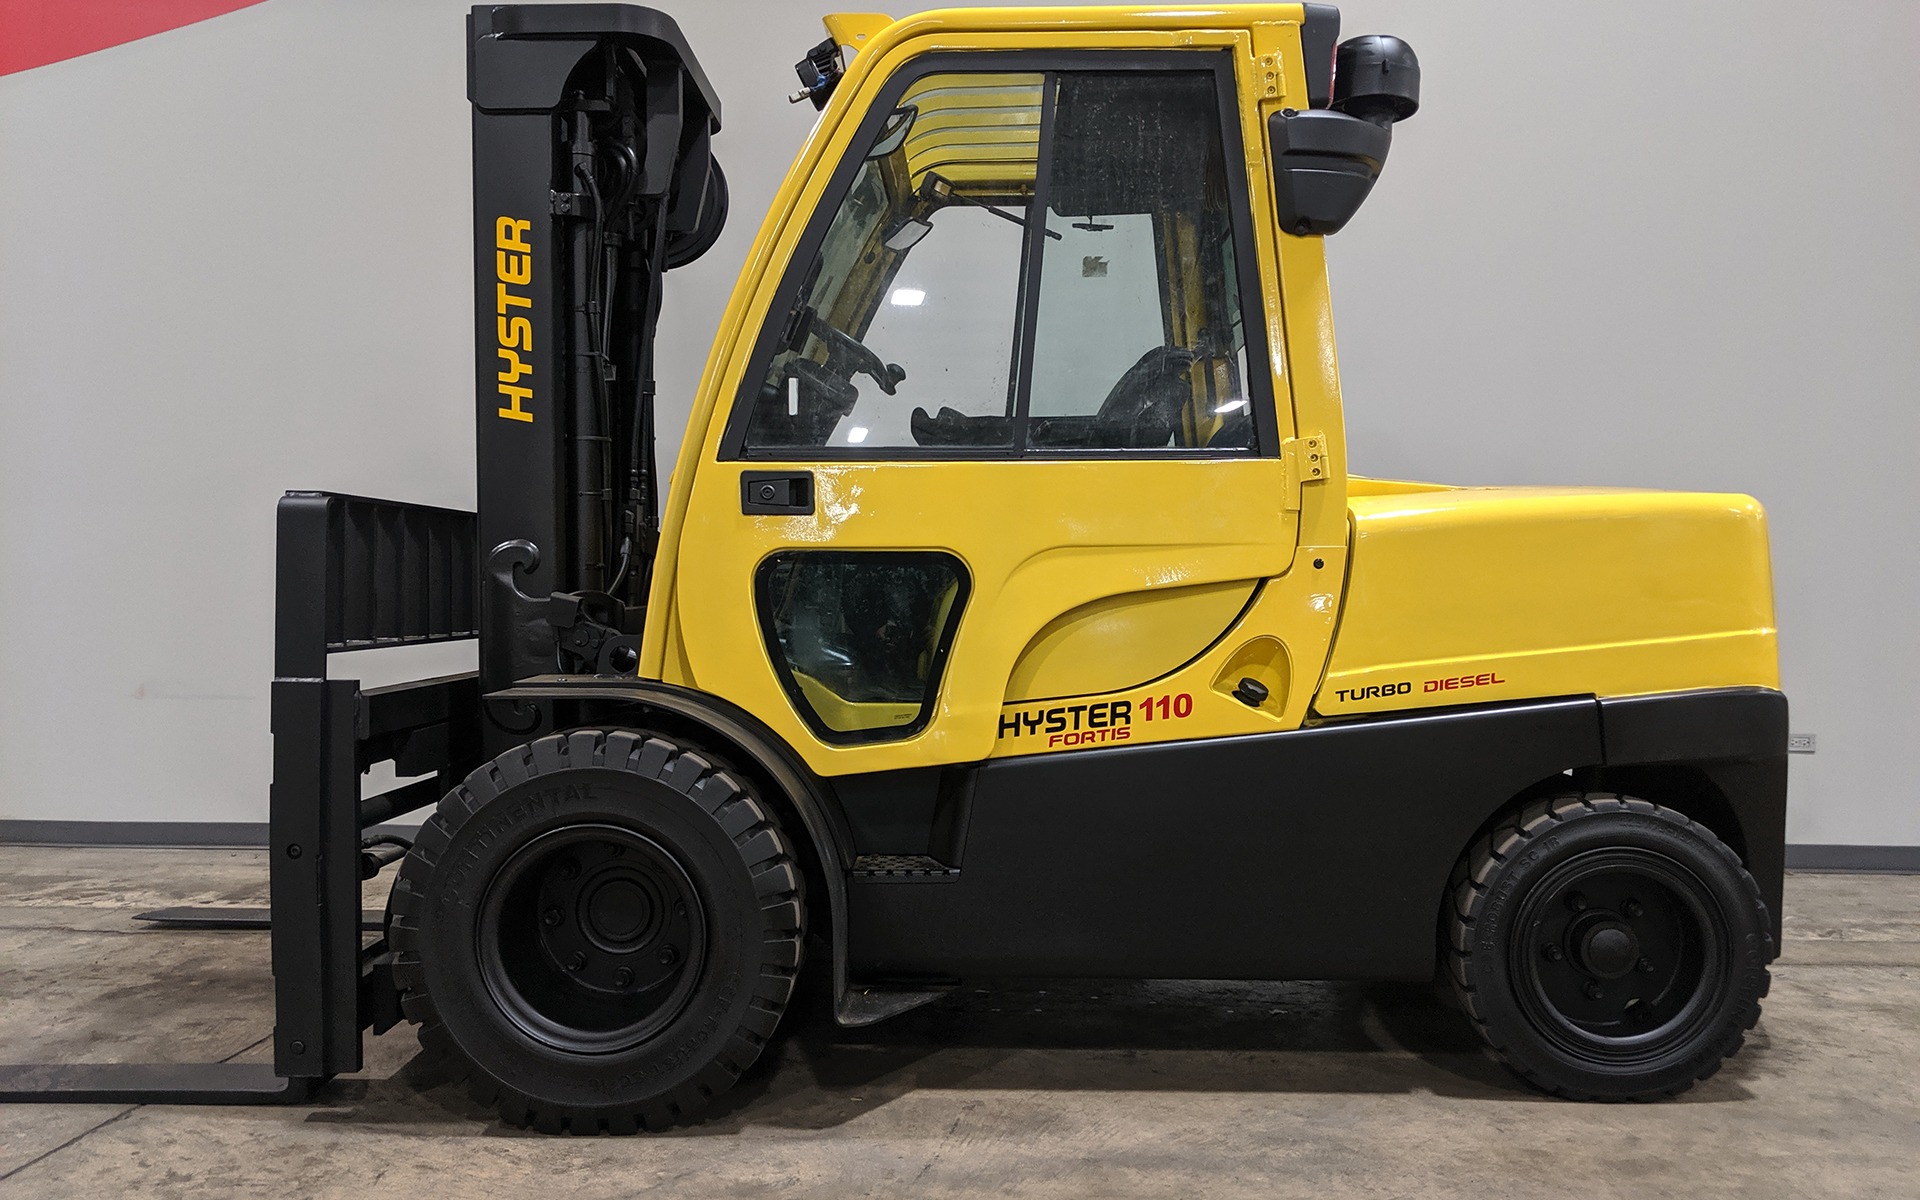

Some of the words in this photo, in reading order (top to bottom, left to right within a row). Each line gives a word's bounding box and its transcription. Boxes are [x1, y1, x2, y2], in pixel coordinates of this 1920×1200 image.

[496, 216, 533, 423] HYSTER
[1335, 681, 1412, 703] TURBO
[1424, 672, 1506, 694] DIESEL
[998, 700, 1132, 740] HYSTER
[1139, 693, 1193, 722] 110
[1049, 726, 1131, 748] FORTIS
